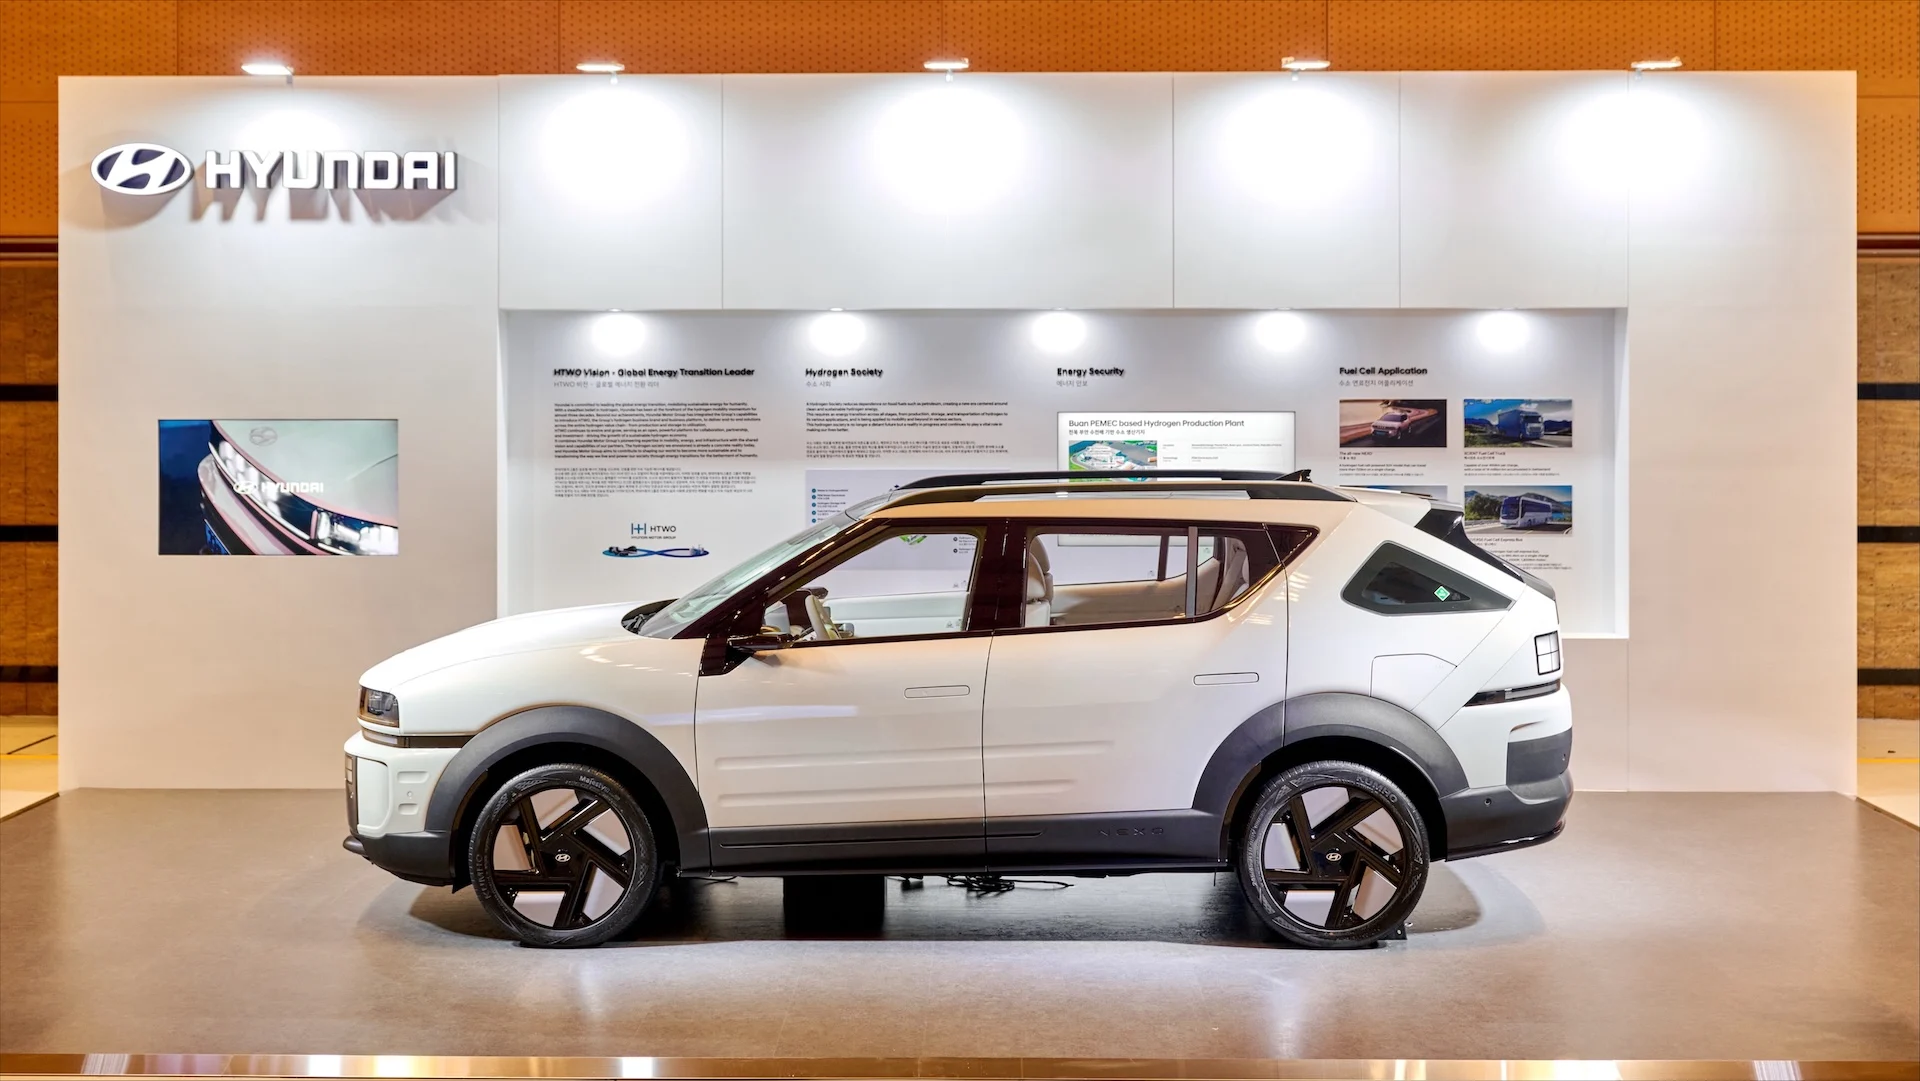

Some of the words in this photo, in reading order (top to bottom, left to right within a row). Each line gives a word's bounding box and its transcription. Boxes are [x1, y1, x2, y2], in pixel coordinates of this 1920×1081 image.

[205, 150, 458, 190] HYUNDAI
[554, 368, 582, 376] HTWO
[584, 368, 610, 376] Vision
[618, 368, 646, 376] Global
[649, 368, 678, 378] Energy
[680, 368, 723, 376] Transition
[725, 368, 755, 376] Leader
[806, 368, 848, 378] Hydrogen
[851, 368, 883, 378] Society
[1057, 368, 1087, 377] Energy
[1089, 368, 1124, 377] Security
[1378, 367, 1427, 375] Application
[1144, 420, 1181, 428] Hydrogen
[262, 482, 324, 493] HYUNDAI
[1356, 775, 1398, 803] KUMHO
[1098, 828, 1164, 836] NEXO
[475, 854, 491, 900] KUMHO
